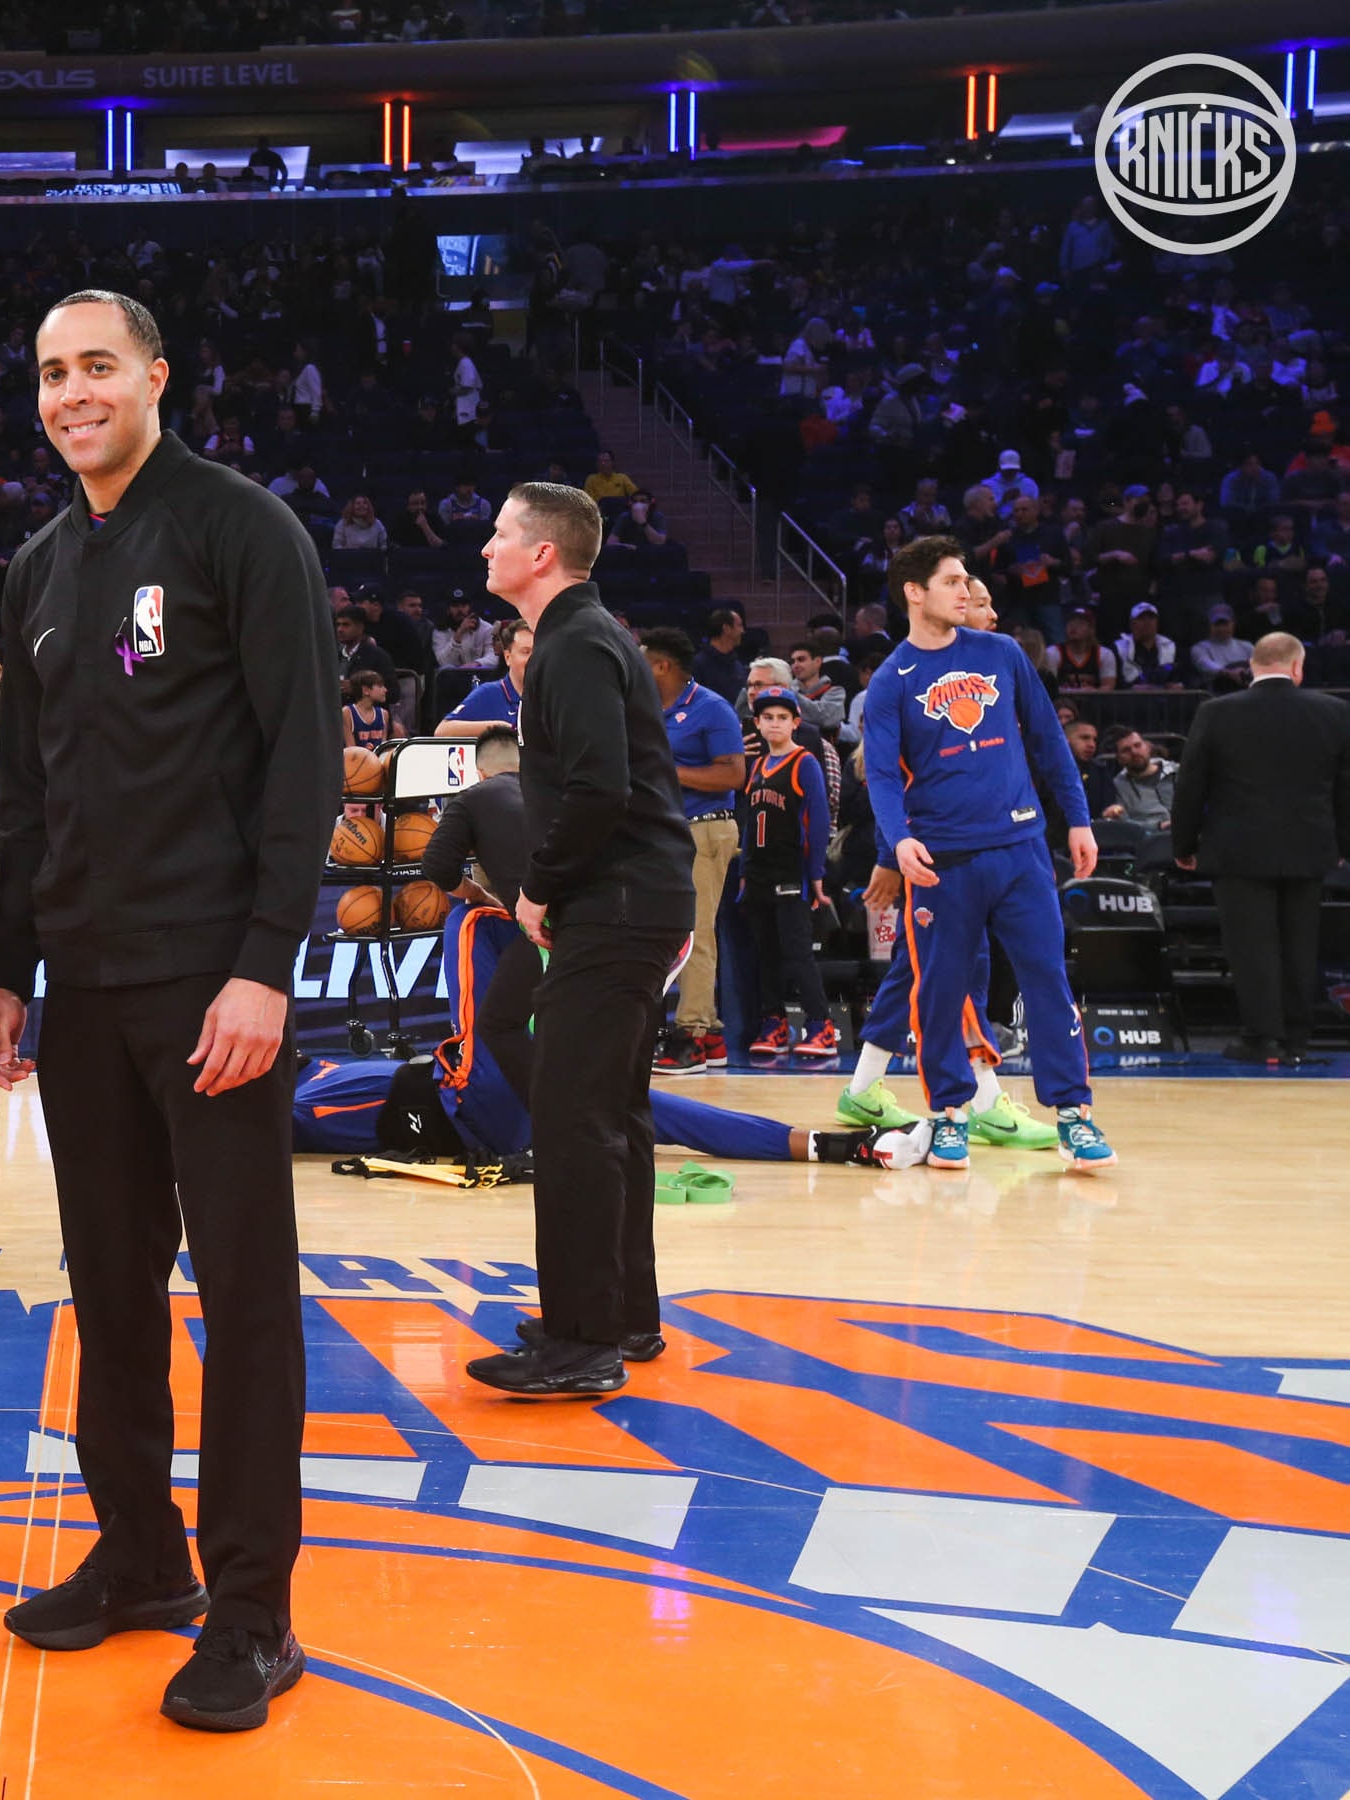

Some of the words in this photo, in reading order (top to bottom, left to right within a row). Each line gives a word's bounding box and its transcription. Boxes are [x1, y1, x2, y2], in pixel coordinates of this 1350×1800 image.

[143, 65, 214, 88] SUITE
[223, 62, 299, 86] LEVEL
[138, 640, 154, 652] NBA
[928, 674, 997, 714] KNICKS
[757, 811, 766, 847] 1
[1098, 894, 1154, 913] HUB
[293, 932, 450, 999] LIV
[1118, 1030, 1162, 1045] HUB
